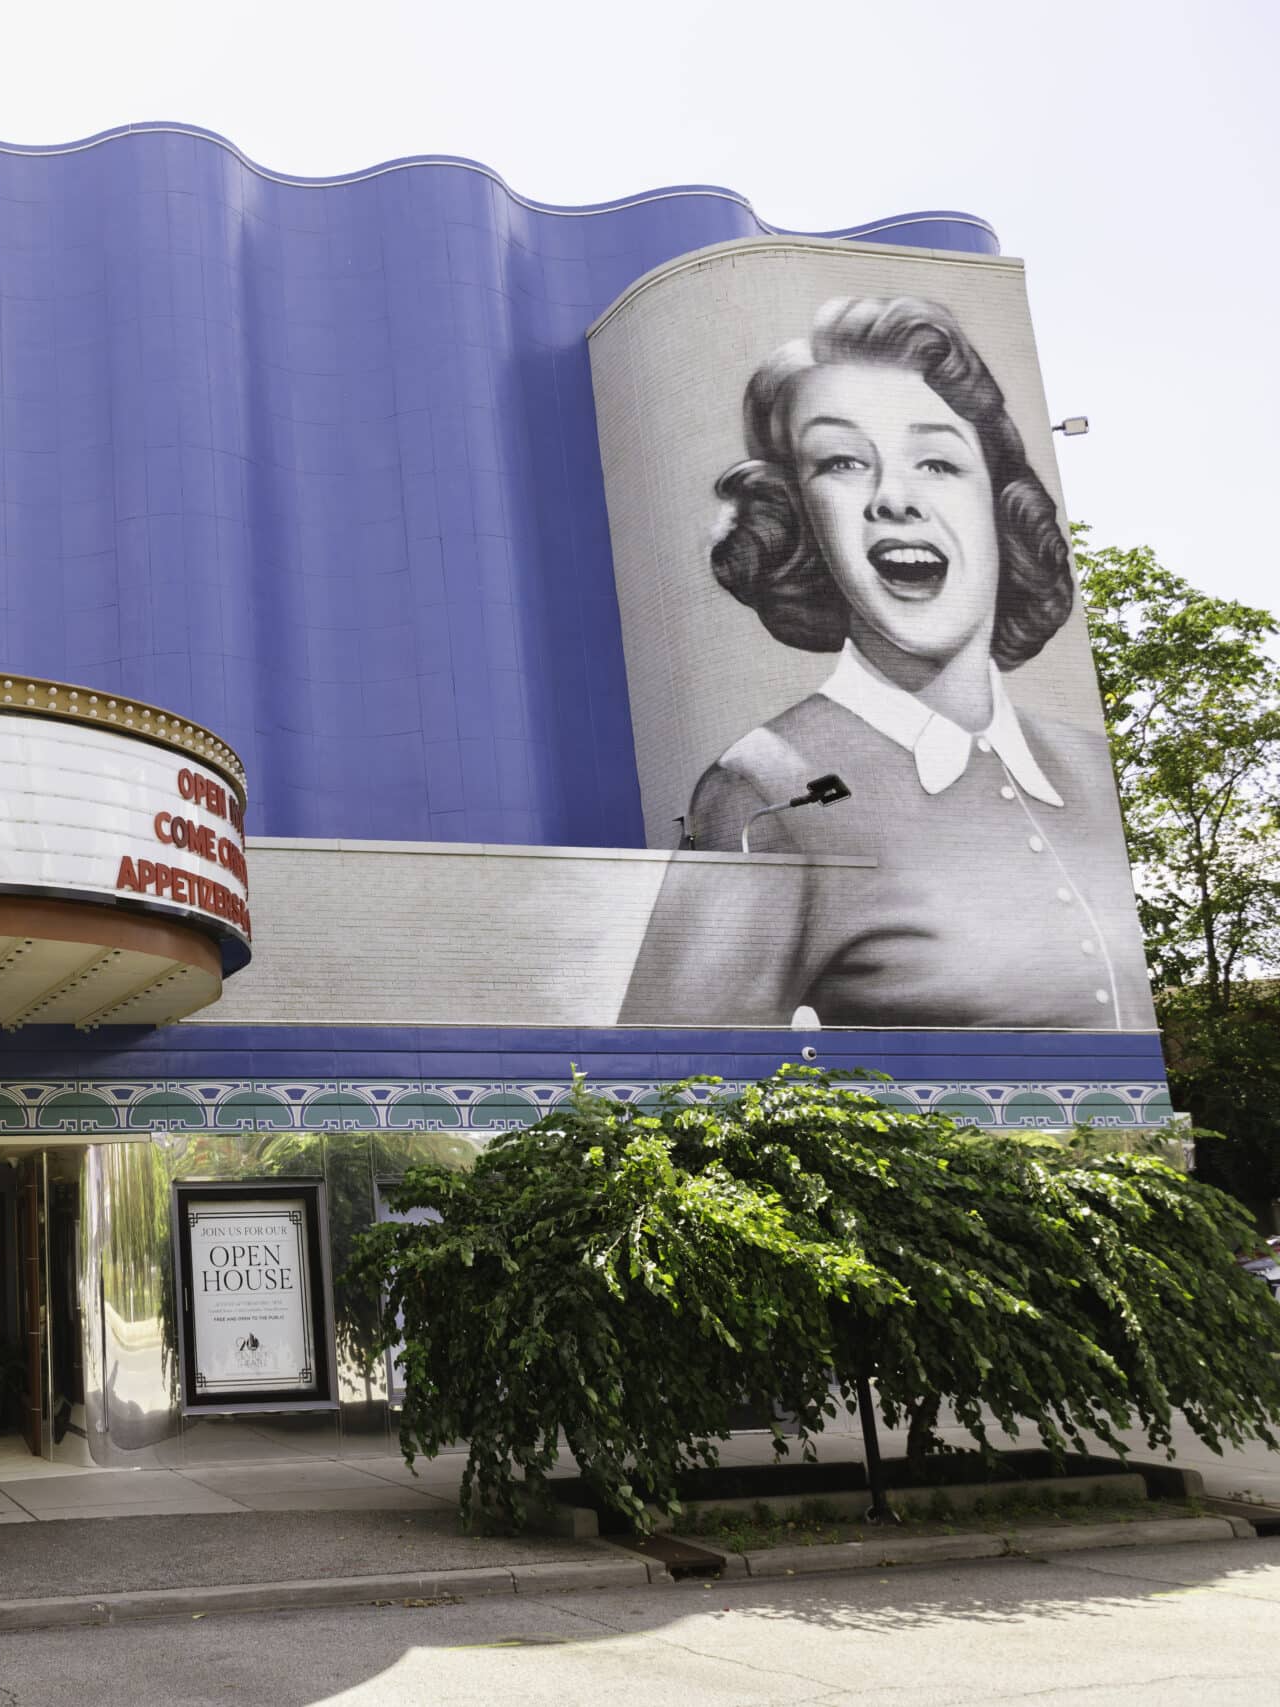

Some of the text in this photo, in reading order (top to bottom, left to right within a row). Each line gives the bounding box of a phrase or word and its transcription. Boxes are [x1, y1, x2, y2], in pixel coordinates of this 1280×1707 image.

[178, 768, 227, 819] OPEN
[154, 811, 217, 862] COME
[201, 1225, 288, 1237] JOIN US FOR OUR
[210, 1244, 280, 1268] OPEN
[201, 1268, 293, 1292] HOUSE
